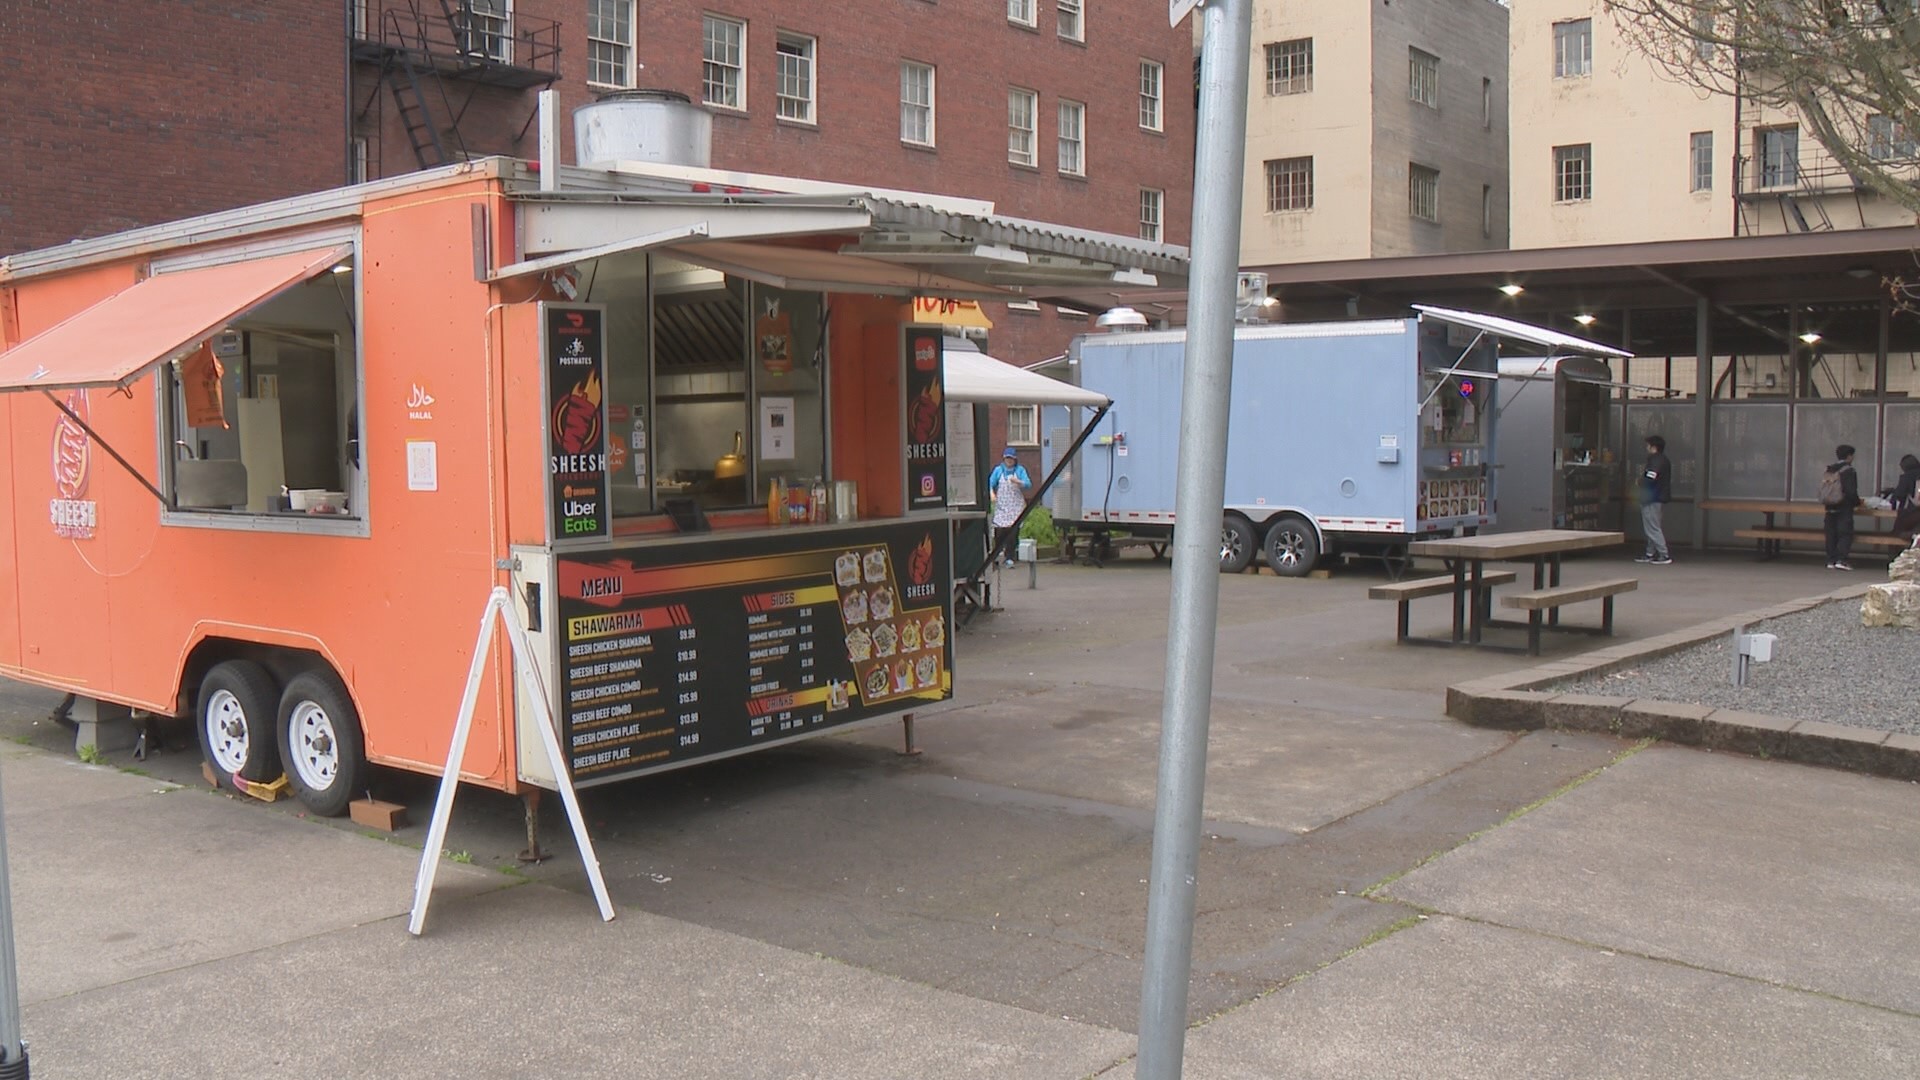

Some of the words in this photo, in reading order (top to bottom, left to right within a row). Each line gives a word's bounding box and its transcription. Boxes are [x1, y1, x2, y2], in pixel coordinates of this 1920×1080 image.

[559, 357, 592, 365] POSTMATES
[409, 412, 432, 420] HALAL
[907, 442, 944, 459] SHEESH
[552, 454, 606, 474] SHEESH
[563, 501, 596, 516] Uber
[564, 517, 597, 533] Eats
[582, 576, 622, 598] MENU
[907, 583, 936, 598] SHEESH
[770, 592, 795, 607] SIDES
[573, 613, 644, 636] SHAWARMA
[779, 627, 796, 637] CHICKEN
[569, 643, 592, 657] SHEESH
[593, 640, 618, 653] CHICKEN
[619, 636, 651, 649] SHAWARMA
[570, 666, 594, 679] SHEESH
[594, 663, 609, 676] BEEF
[609, 658, 642, 673] SHAWARMA
[571, 689, 594, 702] SHEESH
[594, 684, 620, 698] CHICKEN
[620, 680, 641, 693] COMBO
[678, 670, 698, 683] $14.99
[572, 711, 595, 724] SHEESH
[596, 708, 610, 720] BEEF
[611, 704, 632, 717] COMBO
[679, 691, 698, 704] $15.99
[573, 732, 596, 747] SHEESH
[597, 728, 621, 742] CHICKEN
[622, 724, 640, 737] PLATE
[680, 712, 699, 725] $13.99
[573, 755, 597, 769] SHEESH
[597, 751, 612, 764] BEEF
[613, 747, 631, 760] PLATE
[680, 733, 699, 746] $14.99
